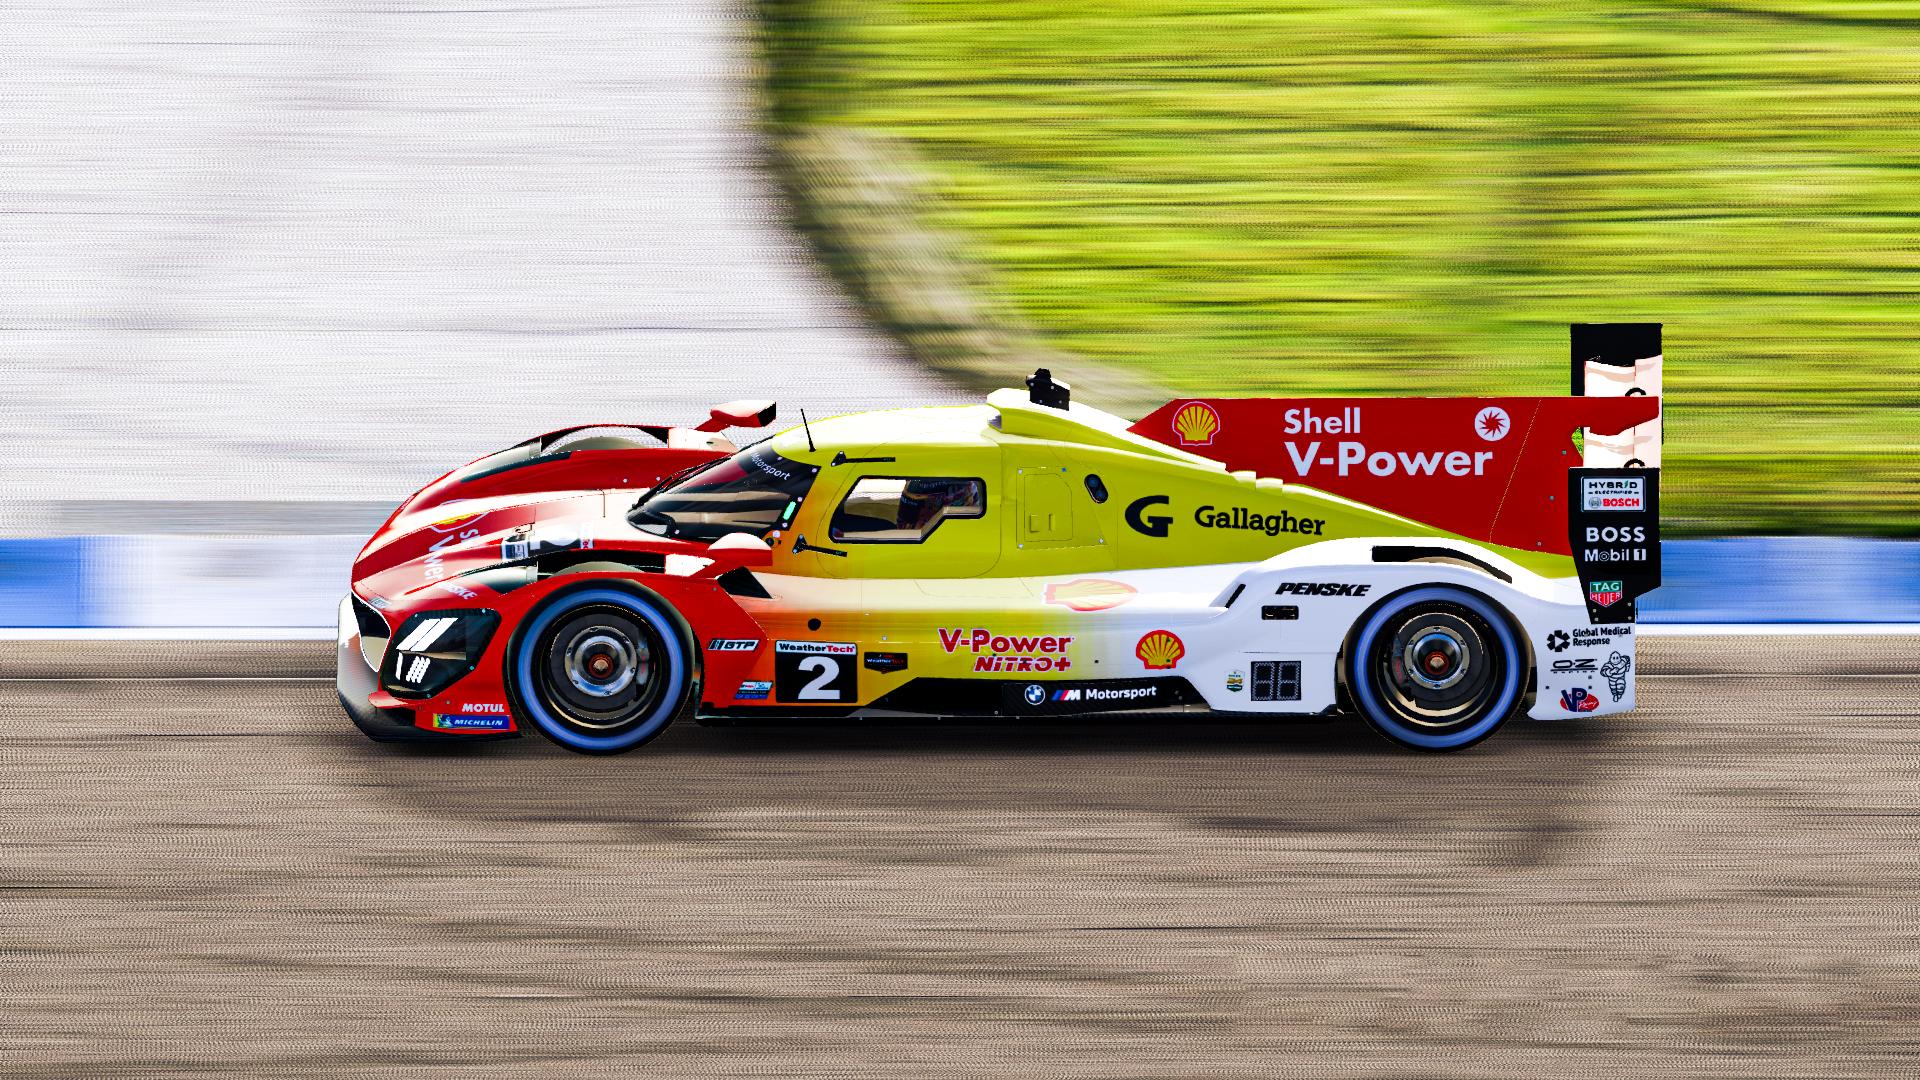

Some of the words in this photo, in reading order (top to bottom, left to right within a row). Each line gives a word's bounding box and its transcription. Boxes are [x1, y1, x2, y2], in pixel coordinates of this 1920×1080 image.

[1284, 407, 1361, 434] Shell
[1284, 441, 1493, 476] V-Power
[1589, 480, 1638, 489] HYBRID
[1602, 498, 1640, 507] BOSCH
[1124, 495, 1173, 537] G
[1194, 505, 1326, 536] Gallagher
[1586, 526, 1646, 543] BOSS
[1584, 548, 1629, 562] Mobil
[1275, 582, 1372, 597] PENSKE
[1592, 582, 1620, 591] TAG
[1592, 592, 1620, 605] HEUER
[1573, 627, 1598, 638] Global
[1601, 626, 1632, 636] Medical
[723, 640, 756, 650] GTP
[938, 628, 1073, 653] V-Power
[1573, 637, 1611, 648] Response
[778, 643, 855, 653] WeatherTech
[798, 655, 840, 700] 2
[1086, 686, 1158, 700] Motorsport
[1560, 687, 1588, 712] VP
[462, 703, 505, 713] MOTUL
